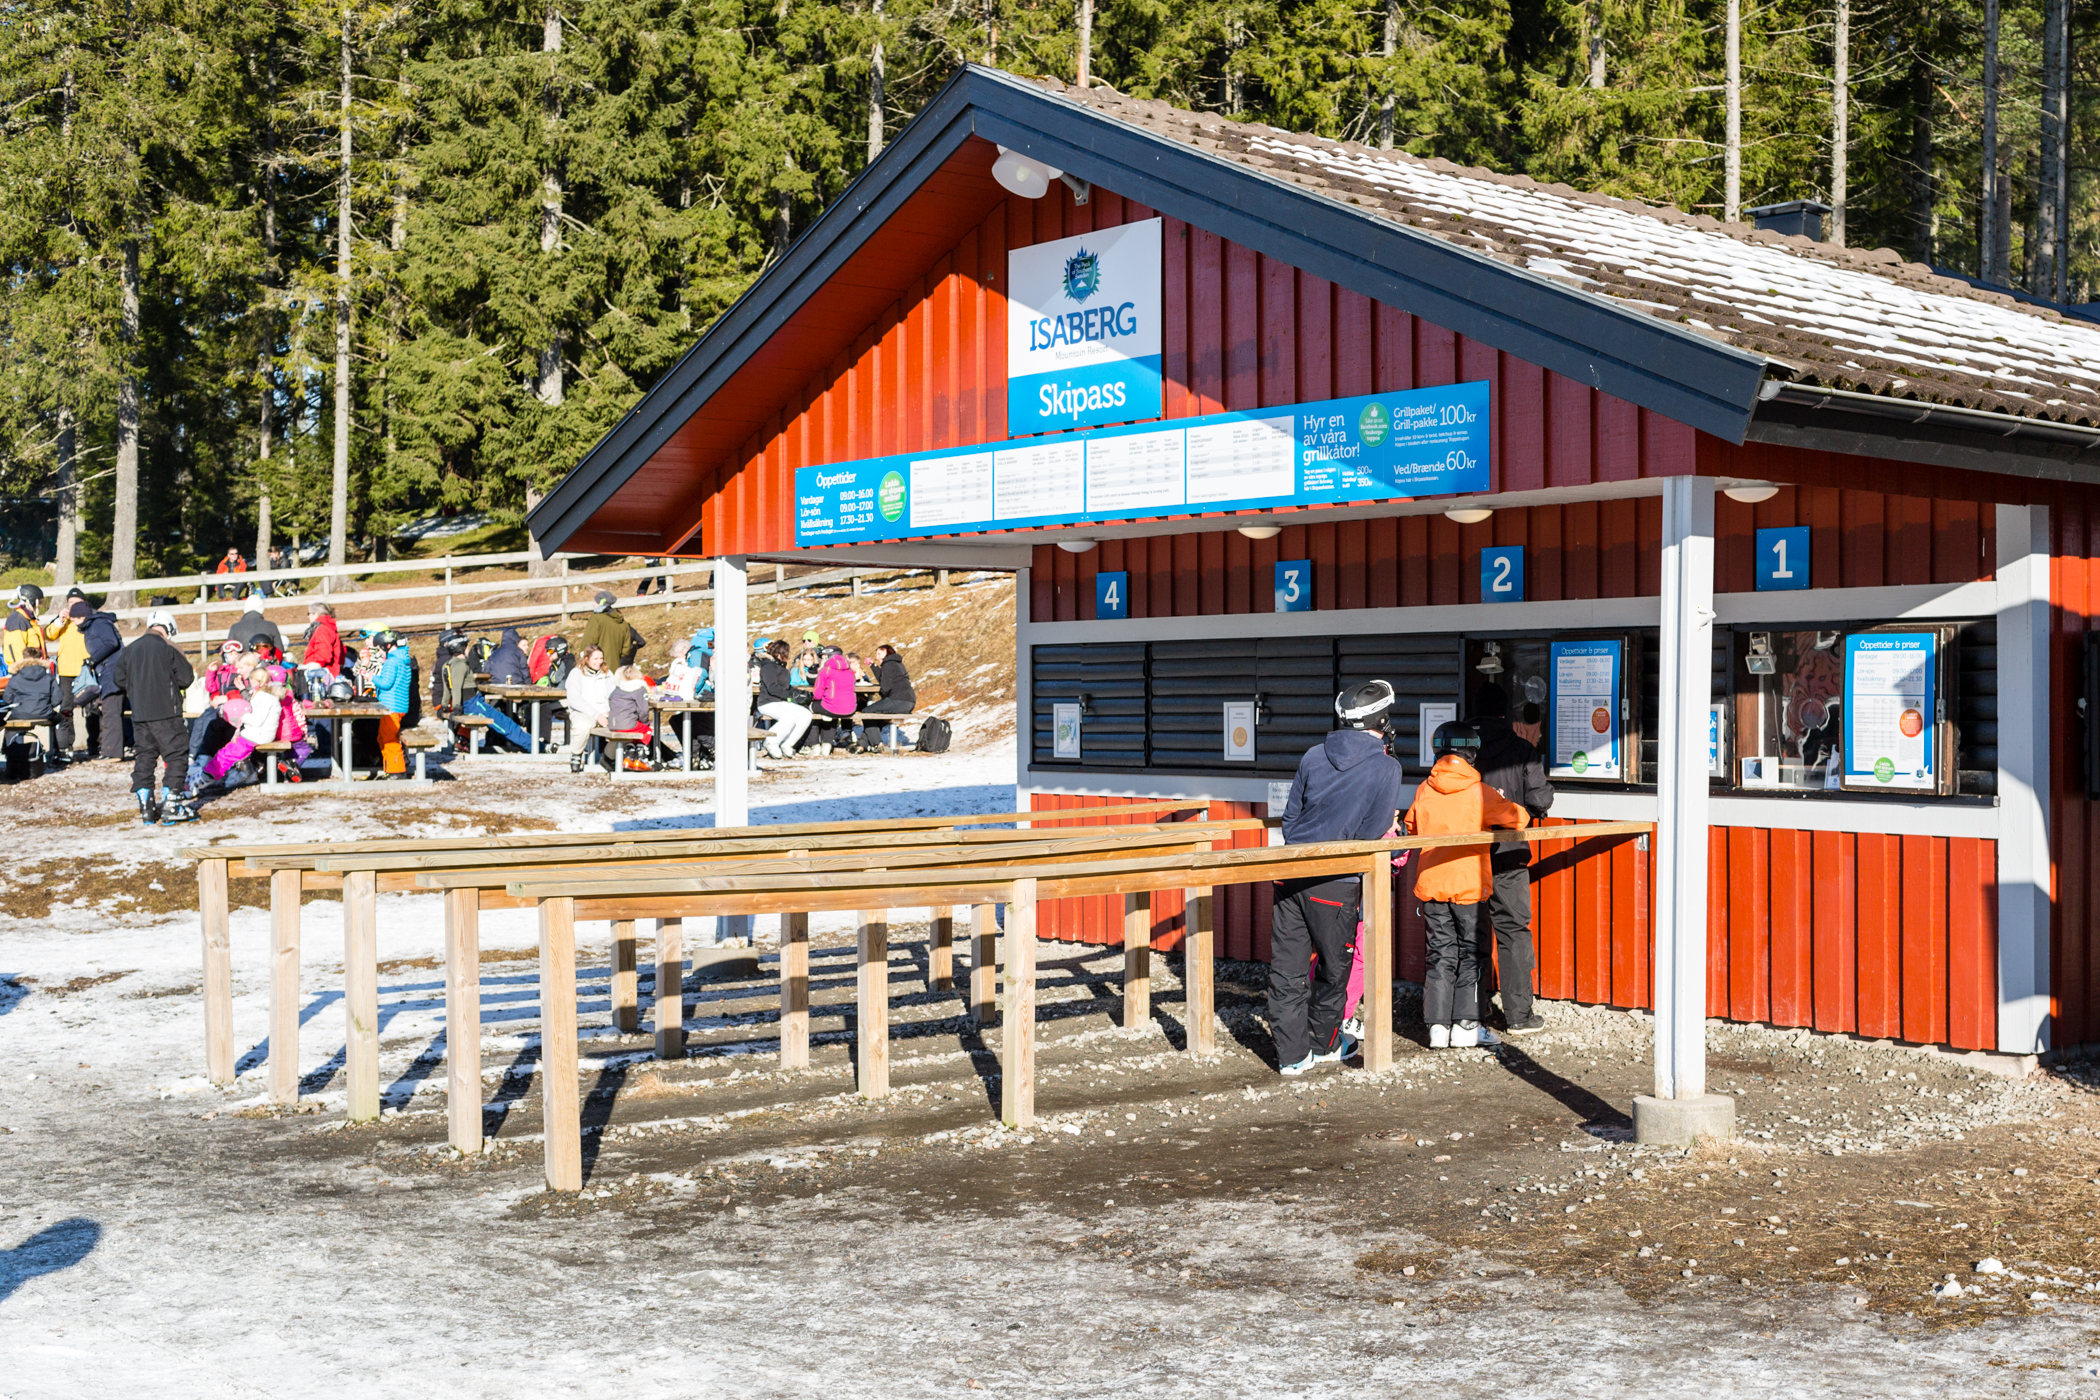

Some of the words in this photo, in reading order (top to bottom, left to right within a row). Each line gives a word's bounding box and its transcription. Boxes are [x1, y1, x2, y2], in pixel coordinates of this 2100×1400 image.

[1029, 302, 1137, 351] ISABERG
[1055, 349, 1086, 360] Mountain
[1087, 344, 1109, 355] Resort
[1039, 381, 1126, 421] Skipass
[1393, 402, 1436, 419] Grillpaket/
[1303, 414, 1326, 433] Hyr
[1329, 414, 1345, 427] en
[1393, 416, 1438, 431] Grill-pakke
[1303, 434, 1318, 446] av
[1320, 428, 1347, 444] våra
[1303, 442, 1360, 466] grillkåtor!
[1393, 460, 1446, 475] Ved/Brænde
[816, 471, 857, 489] Öppettider
[800, 495, 824, 506] Vardagar
[800, 506, 821, 517] Lör-sön
[1772, 539, 1793, 578] 1
[1493, 556, 1512, 592] 2
[1284, 570, 1300, 602] 3
[1104, 581, 1120, 610] 4
[1561, 647, 1588, 655] Öppettider
[1588, 646, 1593, 654] &
[1593, 647, 1609, 655] priser
[1859, 640, 1894, 651] Öppettider
[1894, 640, 1901, 649] &
[1901, 640, 1921, 650] priser
